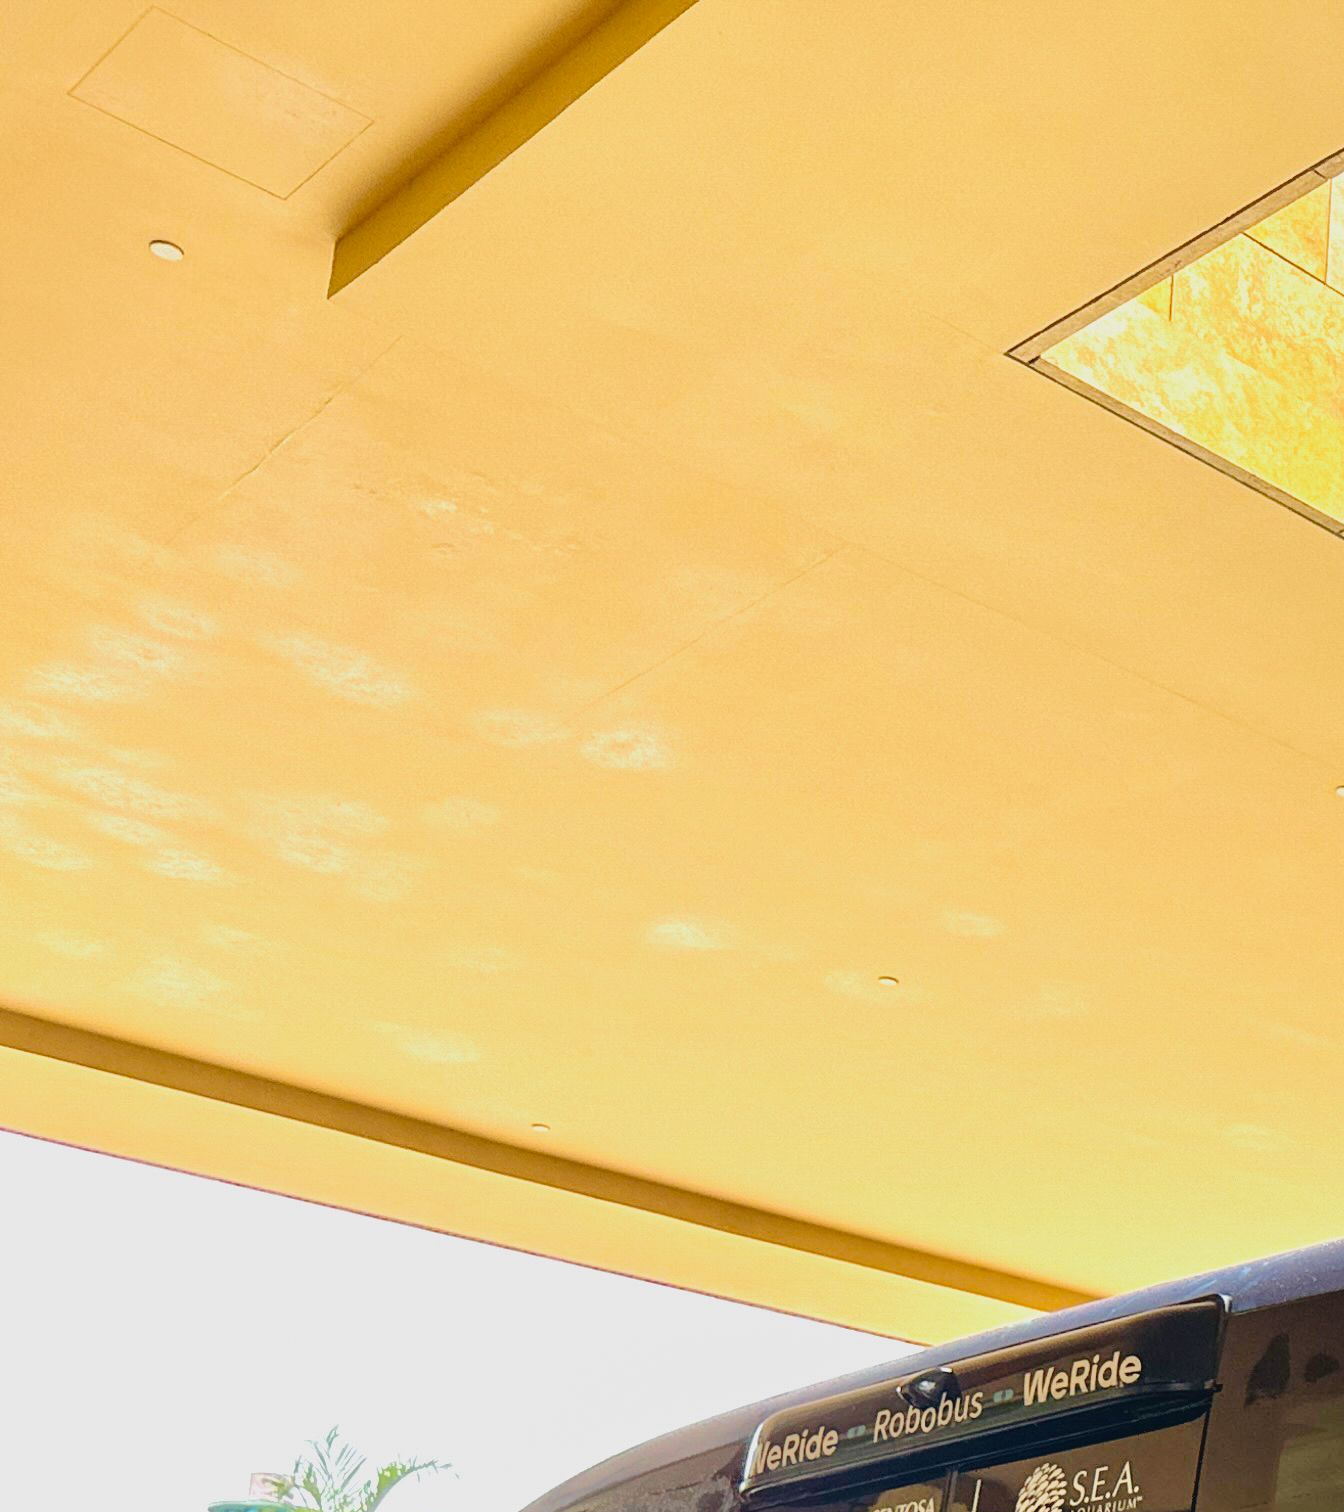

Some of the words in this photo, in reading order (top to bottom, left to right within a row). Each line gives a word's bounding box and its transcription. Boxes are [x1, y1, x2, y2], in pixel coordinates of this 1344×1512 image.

[873, 1390, 984, 1443] Robobus
[1023, 1351, 1142, 1406] WeRide
[1070, 1461, 1140, 1507] S.E.A.
